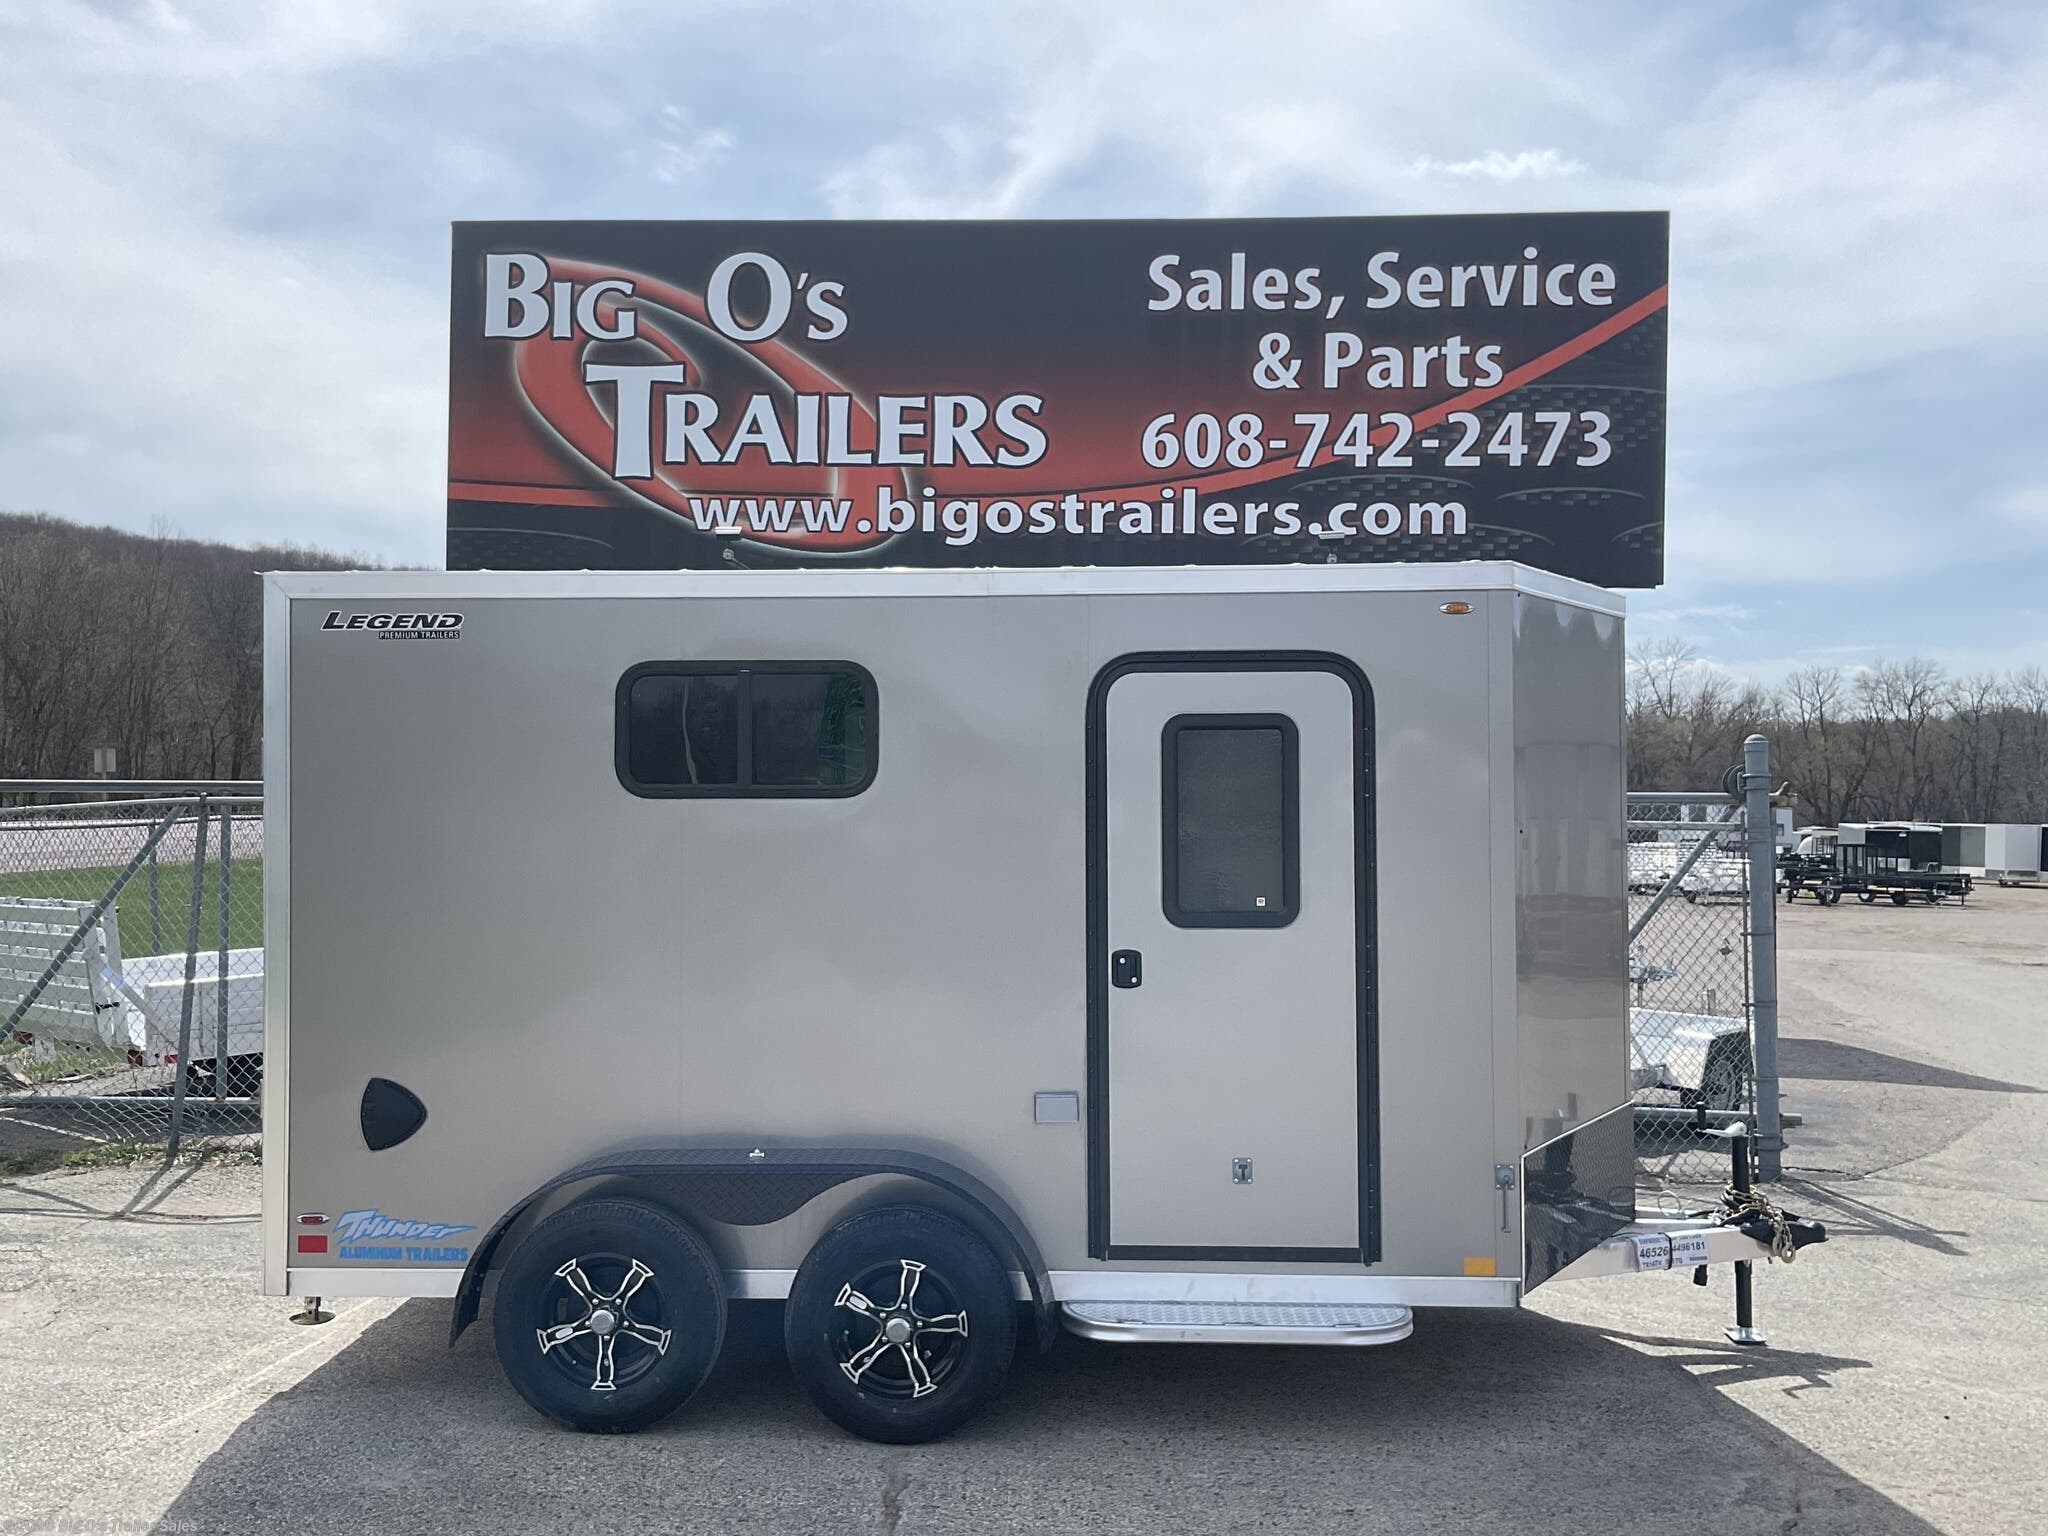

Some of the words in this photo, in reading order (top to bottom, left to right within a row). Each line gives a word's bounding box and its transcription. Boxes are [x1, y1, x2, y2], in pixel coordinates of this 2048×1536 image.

[1146, 251, 1345, 319] Sales,
[1365, 247, 1617, 309] Service
[1252, 332, 1302, 390] &
[1322, 332, 1504, 390] Parts
[584, 362, 1049, 481] TRAILERS
[1140, 409, 1613, 470] 608-742-2473
[687, 486, 1468, 547] www.bigostrailers.com
[320, 611, 464, 632] LEGEND
[379, 631, 419, 640] PREMIUM
[421, 631, 461, 640] TRAILERS
[339, 1246, 403, 1260] ALUMINUM
[407, 1247, 468, 1262] TRAILERS
[1639, 1246, 1669, 1258] 46526
